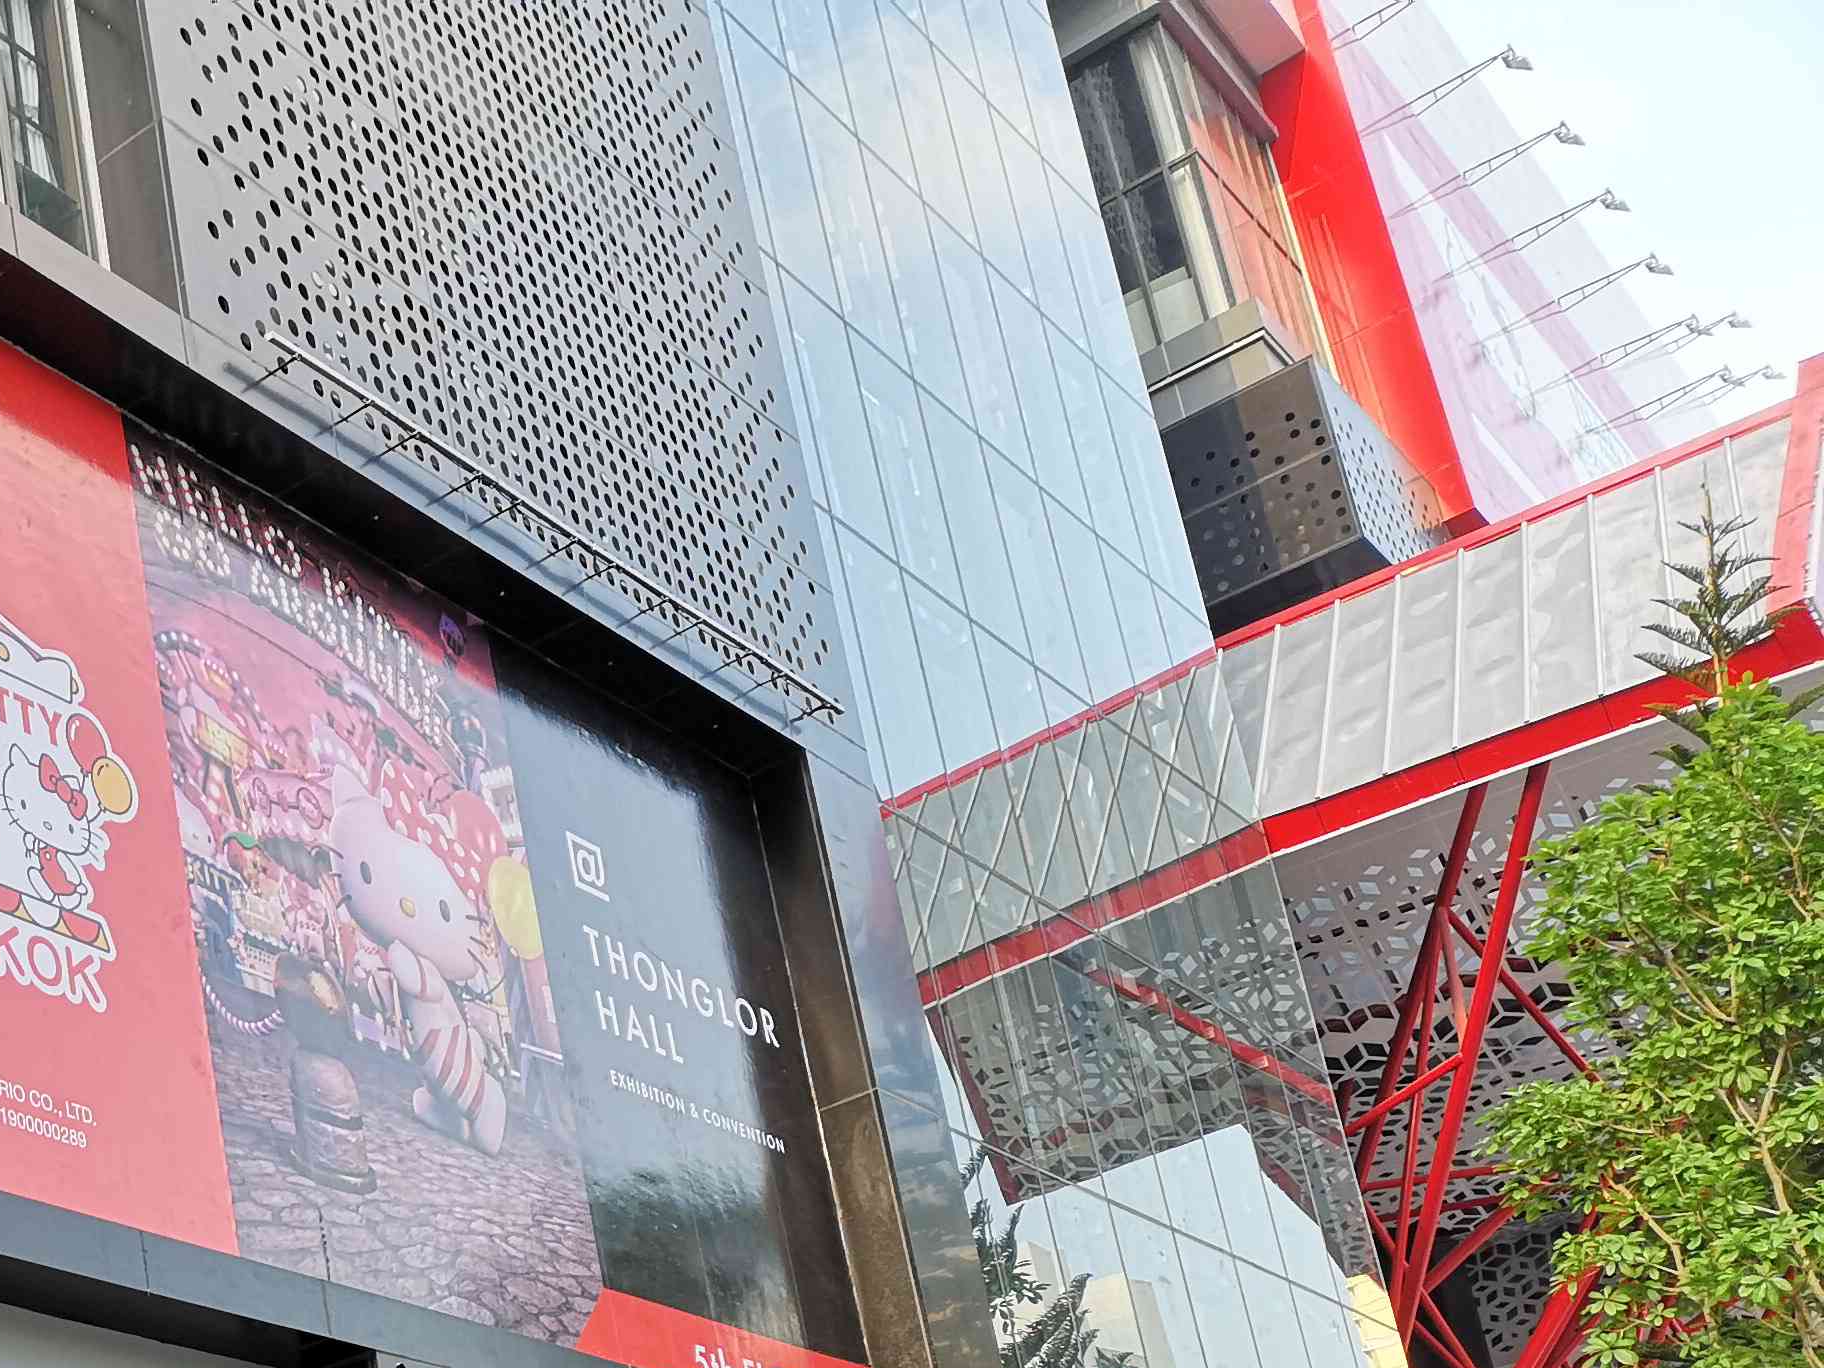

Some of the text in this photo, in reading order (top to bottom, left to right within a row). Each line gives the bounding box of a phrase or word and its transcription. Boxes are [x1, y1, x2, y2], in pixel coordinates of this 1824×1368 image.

[583, 924, 780, 1048] THONGLOR
[595, 990, 684, 1064] HALL
[29, 1090, 63, 1117] CO.,
[65, 1101, 97, 1126] LTD.
[609, 1069, 786, 1154] EXHIBITION & CONVENTION
